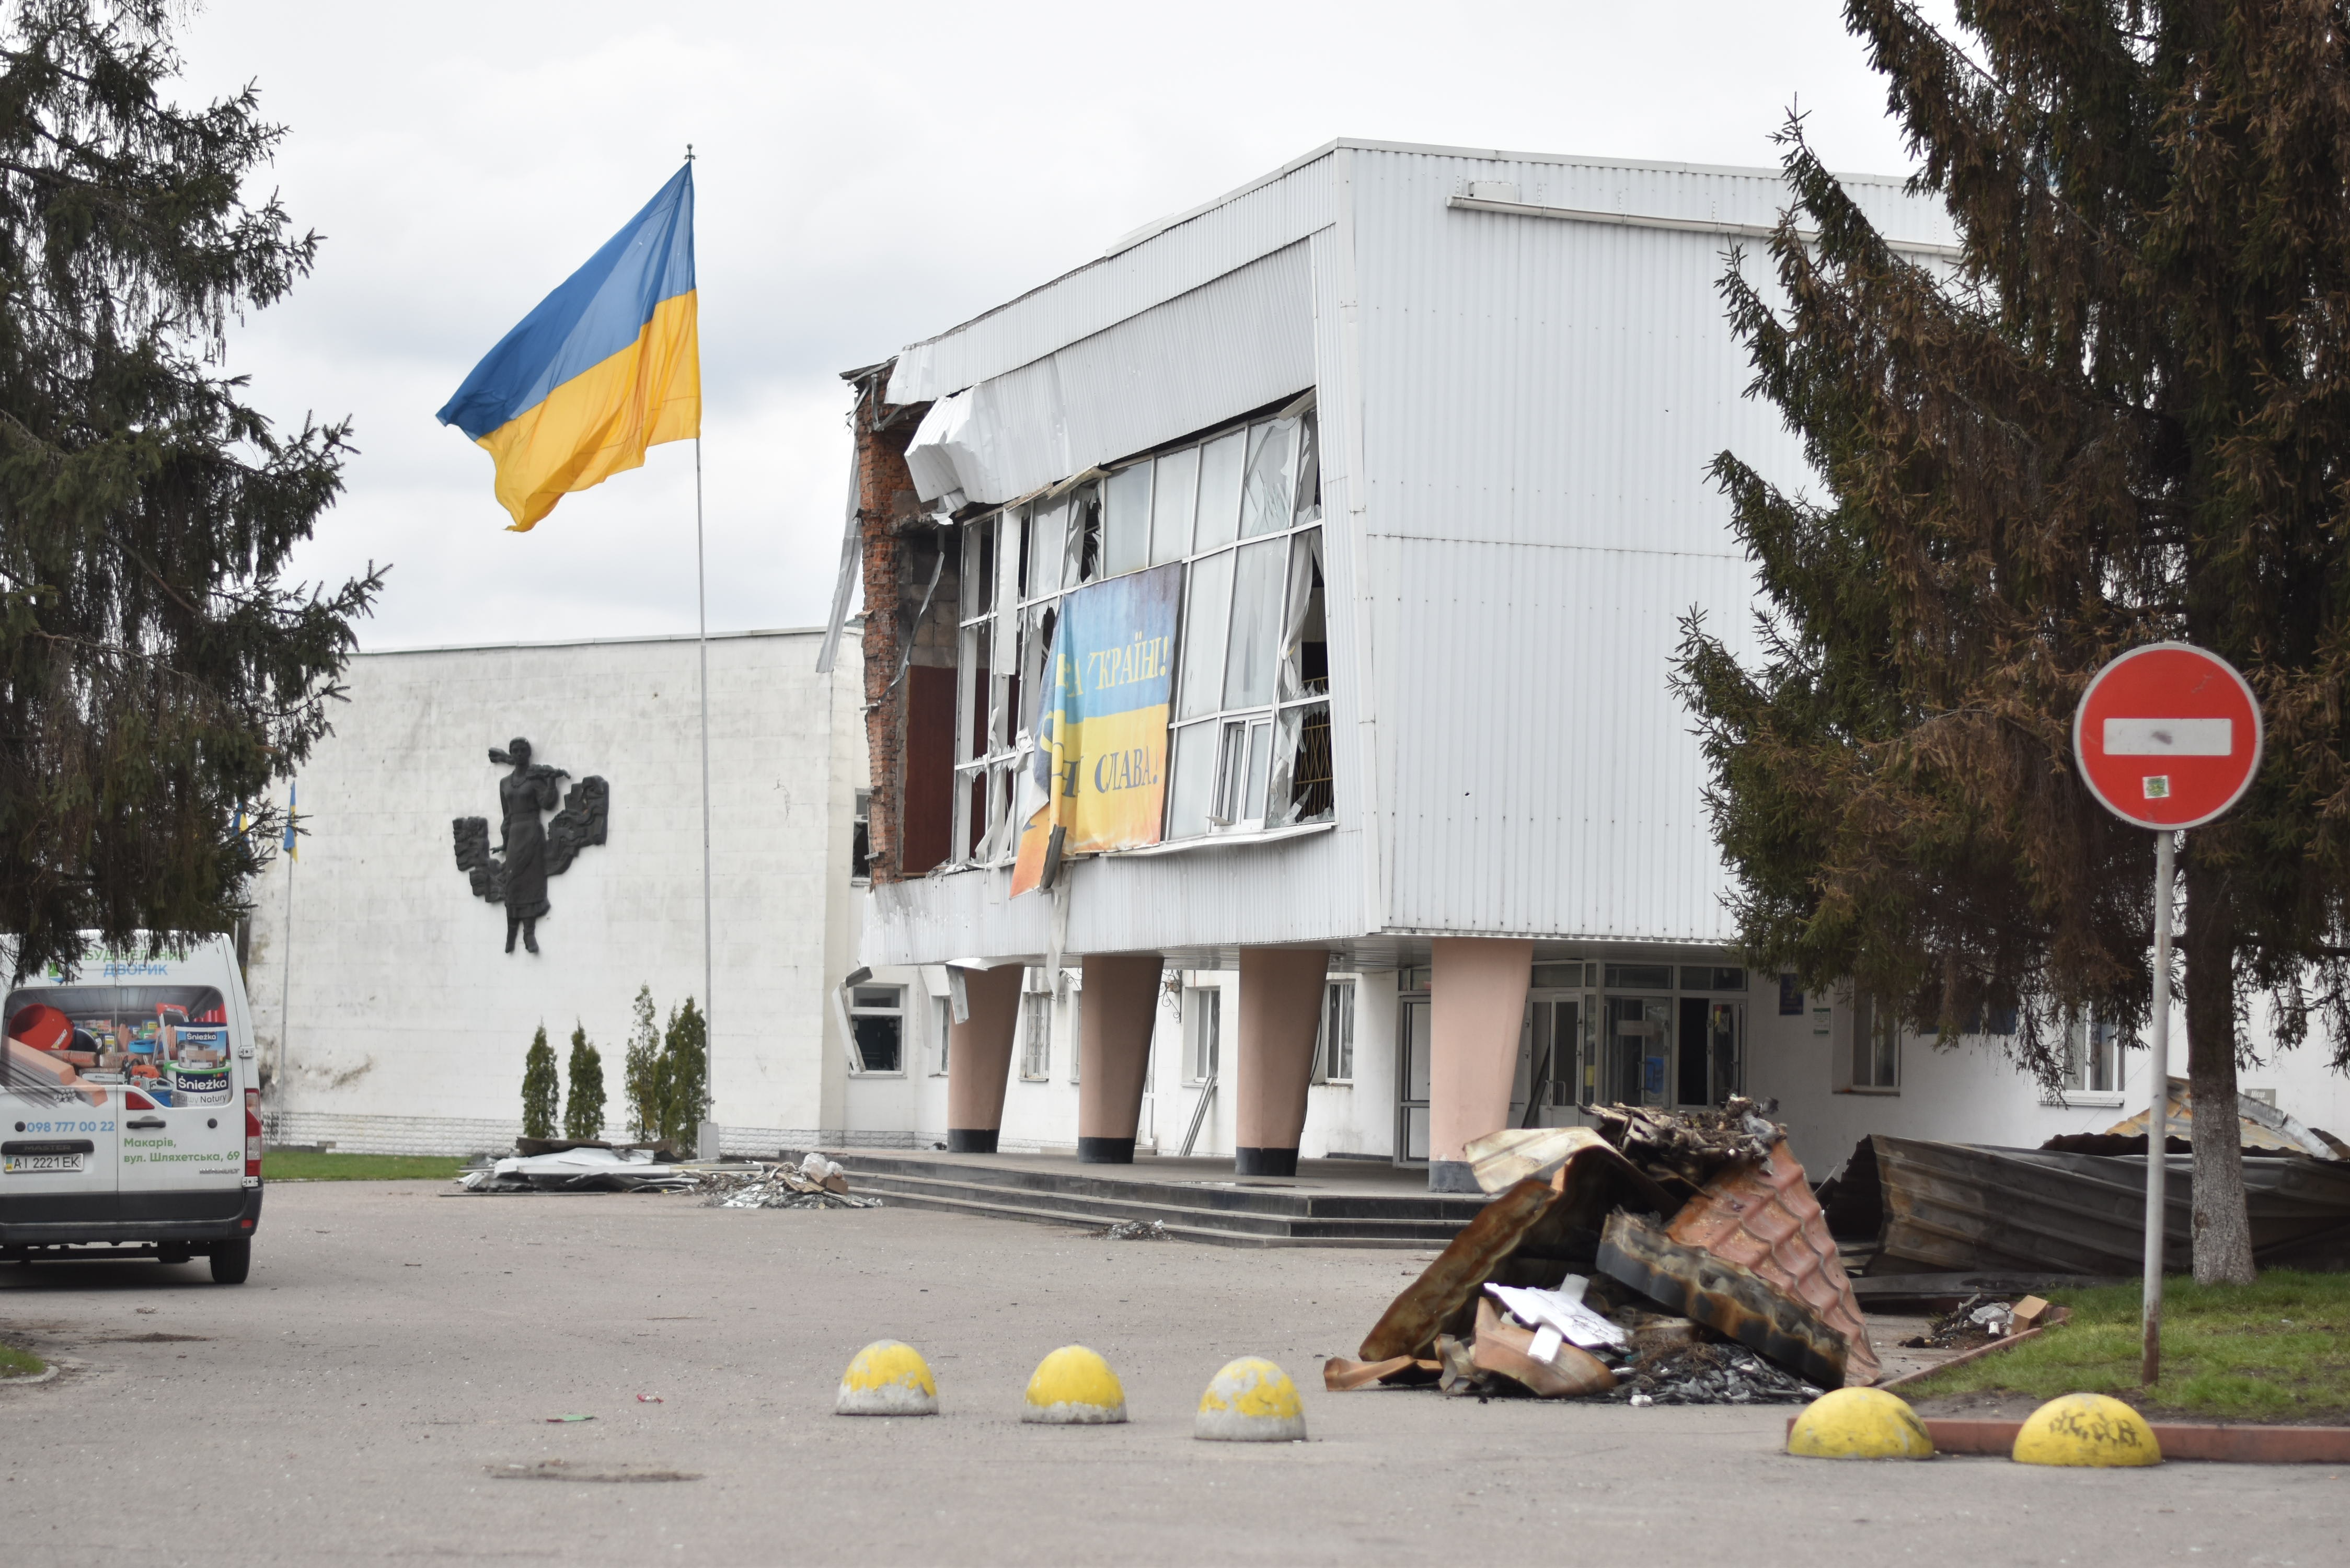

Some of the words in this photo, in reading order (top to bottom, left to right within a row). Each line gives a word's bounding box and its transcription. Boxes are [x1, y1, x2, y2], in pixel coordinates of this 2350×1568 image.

[1095, 746, 1158, 793] СЛАВА!
[103, 964, 168, 977] ДВОРИК
[178, 1076, 227, 1090] Śnieżka
[200, 1094, 227, 1103] Natury
[27, 1122, 51, 1132] 098
[55, 1122, 75, 1132] 777
[79, 1122, 96, 1132] 00
[100, 1121, 114, 1131] 22
[124, 1137, 177, 1149] Макарів,
[33, 1157, 59, 1168] 2221
[124, 1156, 146, 1164] вул.
[150, 1152, 223, 1162] Шляхетська,
[227, 1151, 240, 1160] 69
